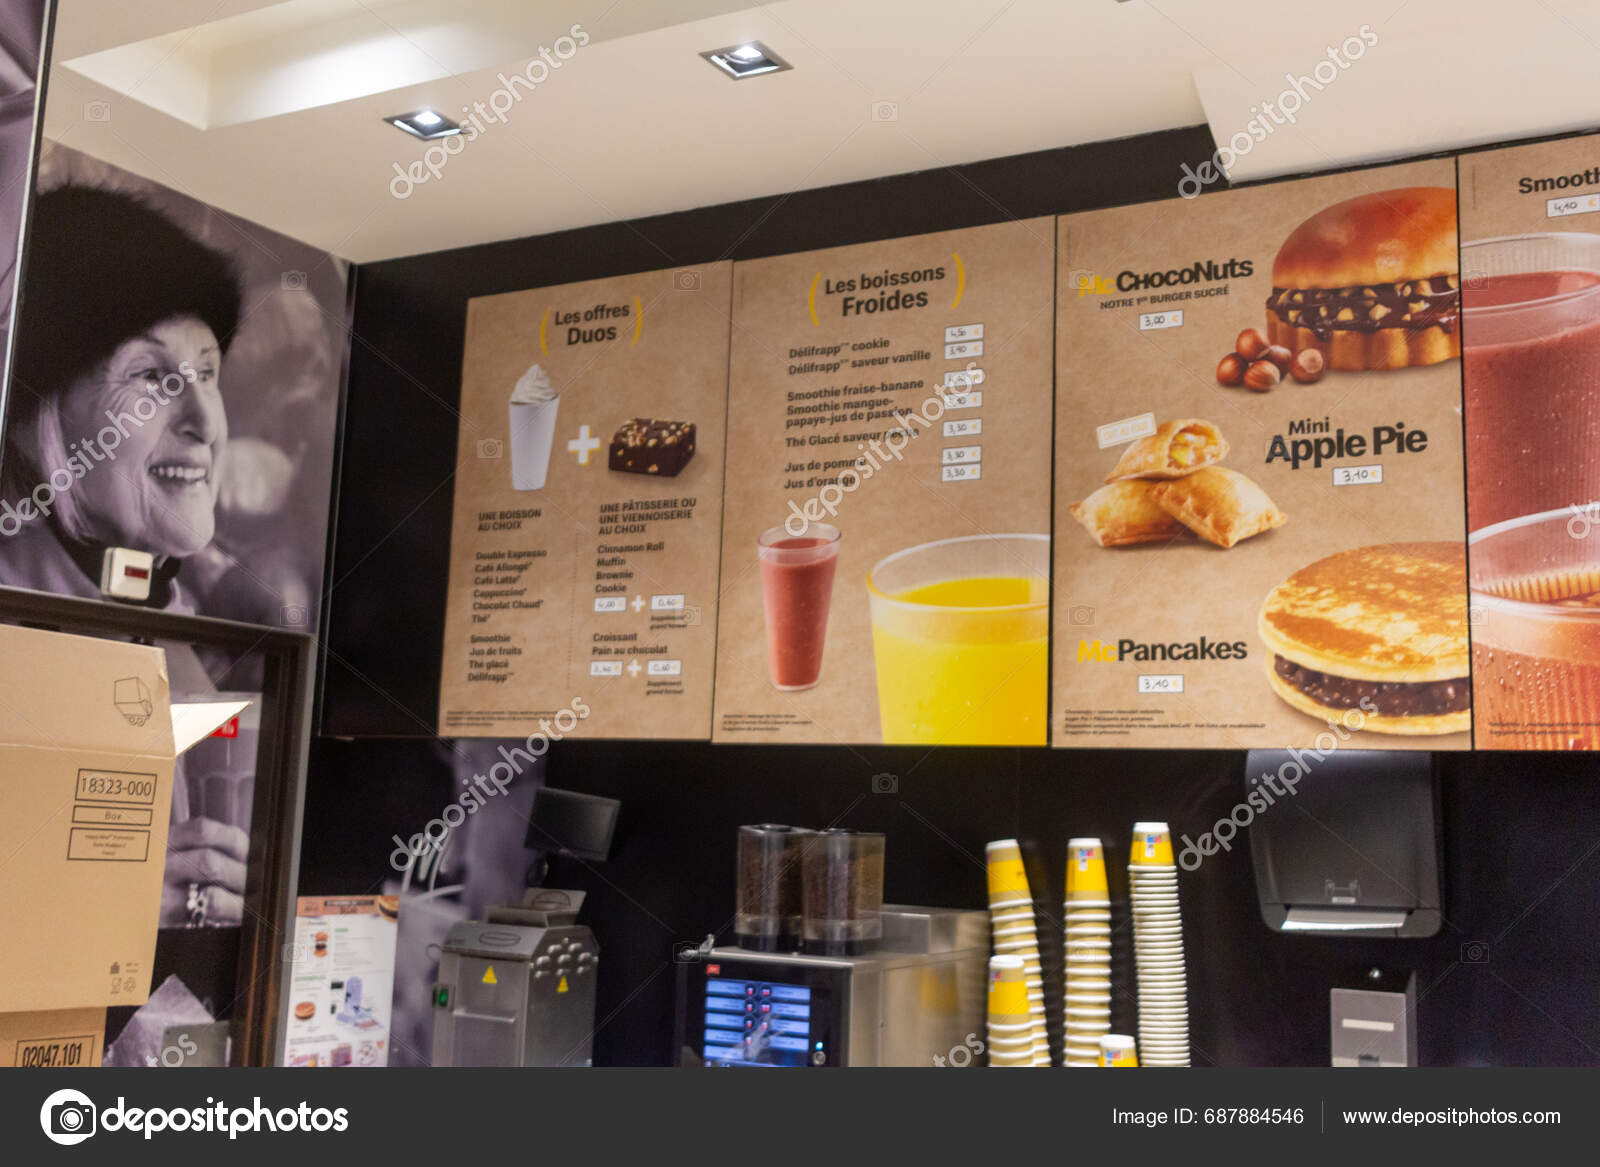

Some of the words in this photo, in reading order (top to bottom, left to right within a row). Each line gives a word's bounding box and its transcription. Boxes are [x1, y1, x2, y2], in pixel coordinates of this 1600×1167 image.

[825, 279, 856, 295] Les
[860, 266, 945, 291] boissons
[842, 290, 928, 317] Froides
[1100, 298, 1134, 310] NOTRE
[1150, 291, 1191, 304] BURGER
[1194, 284, 1230, 299] SUCRÉ
[554, 310, 580, 326] Les
[584, 303, 630, 322] offres
[567, 326, 617, 345] Duos
[851, 337, 890, 351] cookie
[851, 357, 889, 369] saveur
[892, 349, 931, 364] vanille
[787, 388, 841, 402] Smoothie
[843, 379, 924, 396] fraise-banane
[787, 402, 841, 416] Smoothie
[786, 411, 847, 429] papaye-jus
[850, 410, 865, 421] de
[1288, 416, 1330, 436] Mini
[786, 435, 806, 448] Thé
[808, 431, 840, 446] Glacé
[843, 430, 881, 443] saveur
[1265, 428, 1367, 470] Apple
[1373, 422, 1428, 456] Pie
[784, 461, 807, 473] Jus
[807, 459, 821, 471] de
[824, 458, 866, 473] pomme
[784, 478, 803, 490] Jus
[600, 503, 620, 513] UNE
[622, 499, 679, 512] PÂTISSERIE
[681, 497, 697, 508] OU
[478, 511, 497, 521] UNE
[499, 508, 542, 520] BOISSON
[599, 514, 619, 524] UNE
[622, 509, 693, 523] VIENNOISERIE
[478, 522, 490, 532] AU
[492, 520, 522, 531] CHOIX
[598, 526, 612, 536] AU
[614, 524, 647, 535] CHOIX
[597, 543, 645, 554] Cinnamon
[646, 541, 665, 552] Roll
[596, 557, 626, 568] Muffin
[596, 570, 634, 580] Brownie
[595, 583, 627, 594] Cookie
[593, 632, 638, 642] Croissant
[469, 648, 485, 657] Jus
[486, 647, 497, 656] de
[498, 646, 523, 656] fruits
[592, 646, 612, 656] Pain
[614, 647, 625, 655] au
[627, 645, 668, 655] chocolat
[1077, 636, 1248, 663] McPancakes
[82, 776, 152, 796] 18323-000
[22, 1042, 82, 1067] 02047.101
